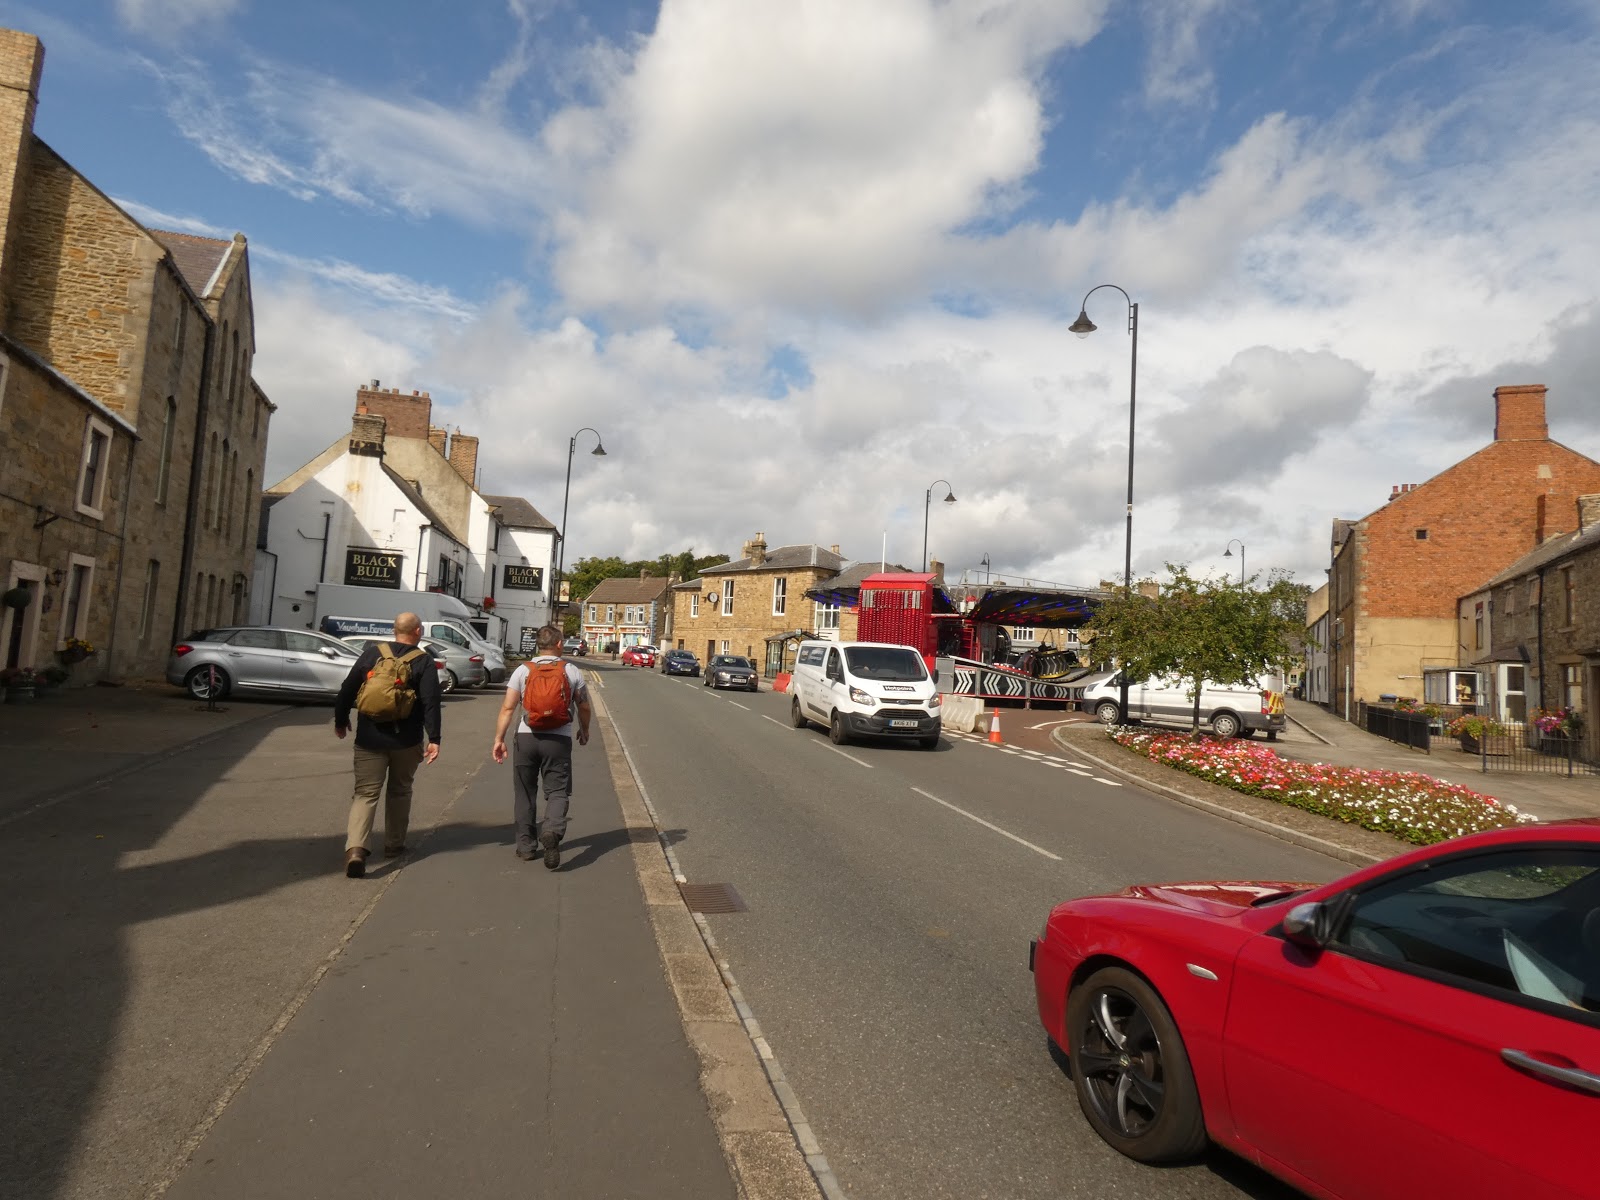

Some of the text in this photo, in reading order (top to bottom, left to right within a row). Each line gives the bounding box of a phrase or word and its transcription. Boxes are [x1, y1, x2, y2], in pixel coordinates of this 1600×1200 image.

[353, 554, 396, 568] BLACK
[357, 565, 390, 578] BULL
[509, 567, 539, 577] BLACK
[512, 575, 535, 585] BULL
[336, 621, 368, 633] Vaughan
